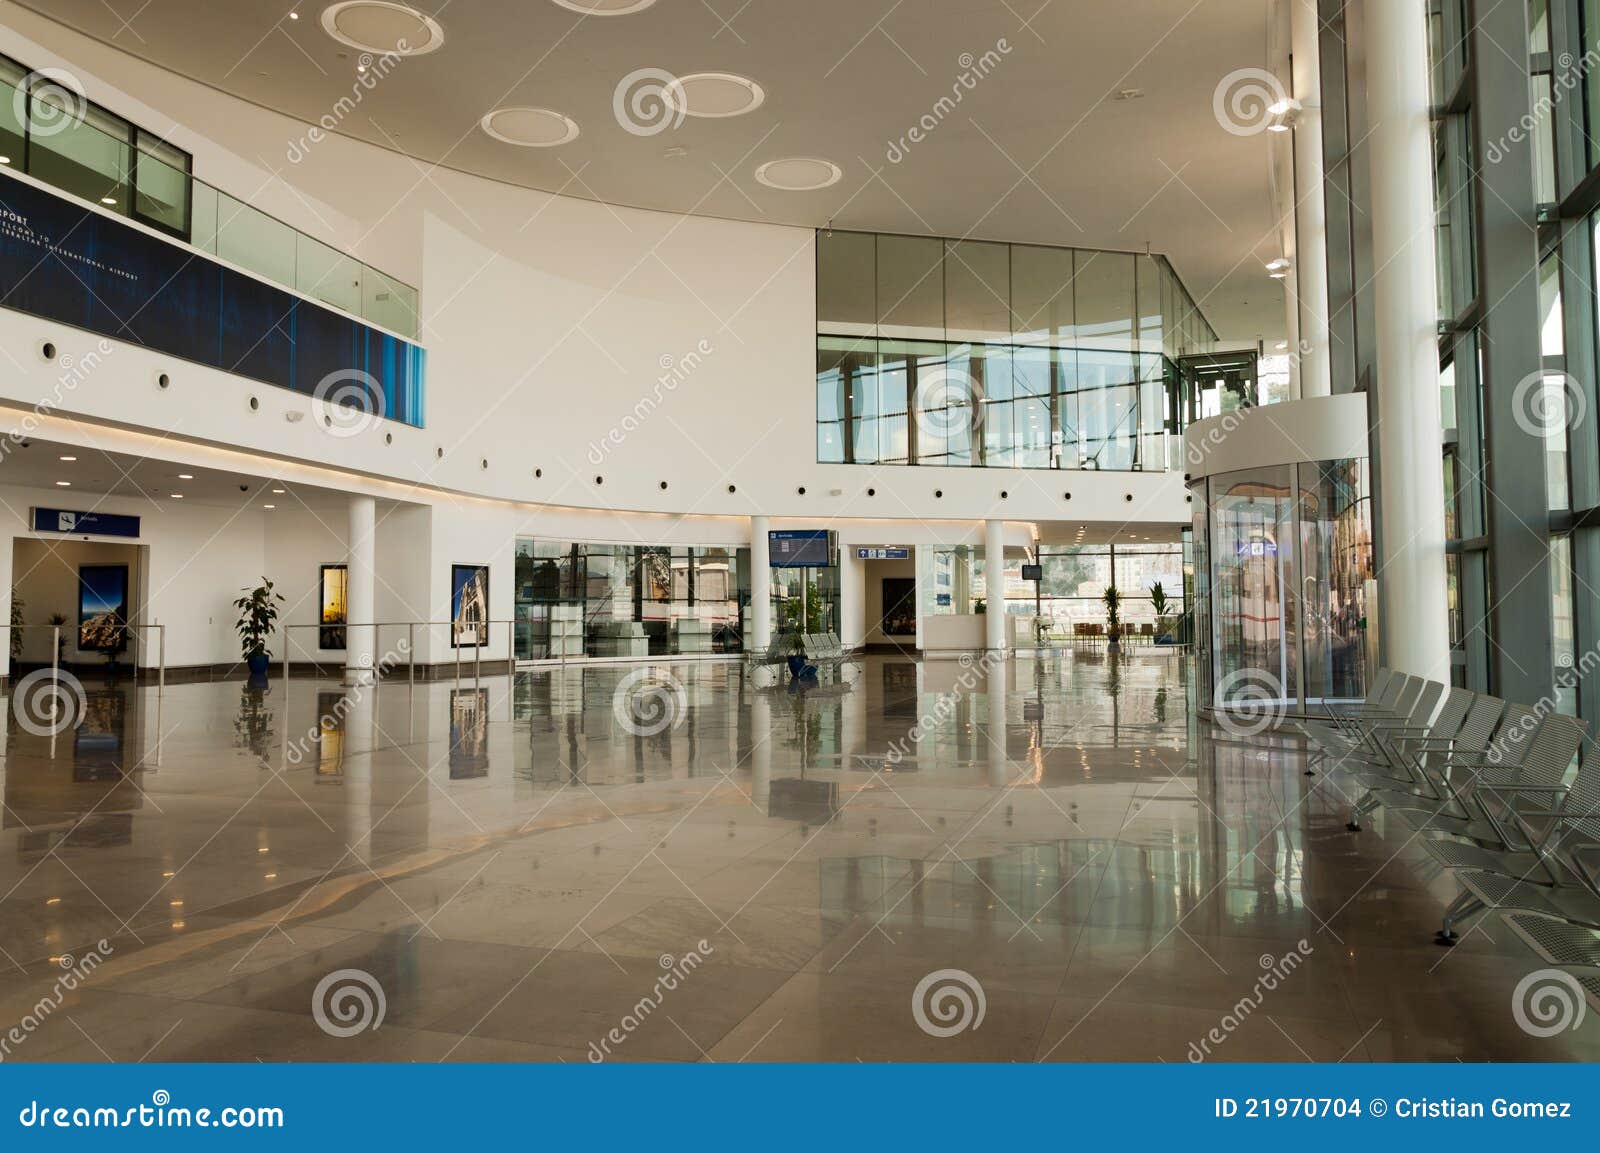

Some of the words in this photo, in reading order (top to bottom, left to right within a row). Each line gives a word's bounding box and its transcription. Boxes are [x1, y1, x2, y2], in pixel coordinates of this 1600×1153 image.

[0, 220, 34, 237] ELCOME
[45, 243, 105, 270] INTERNATIONAL
[109, 267, 138, 280] AIRPORT
